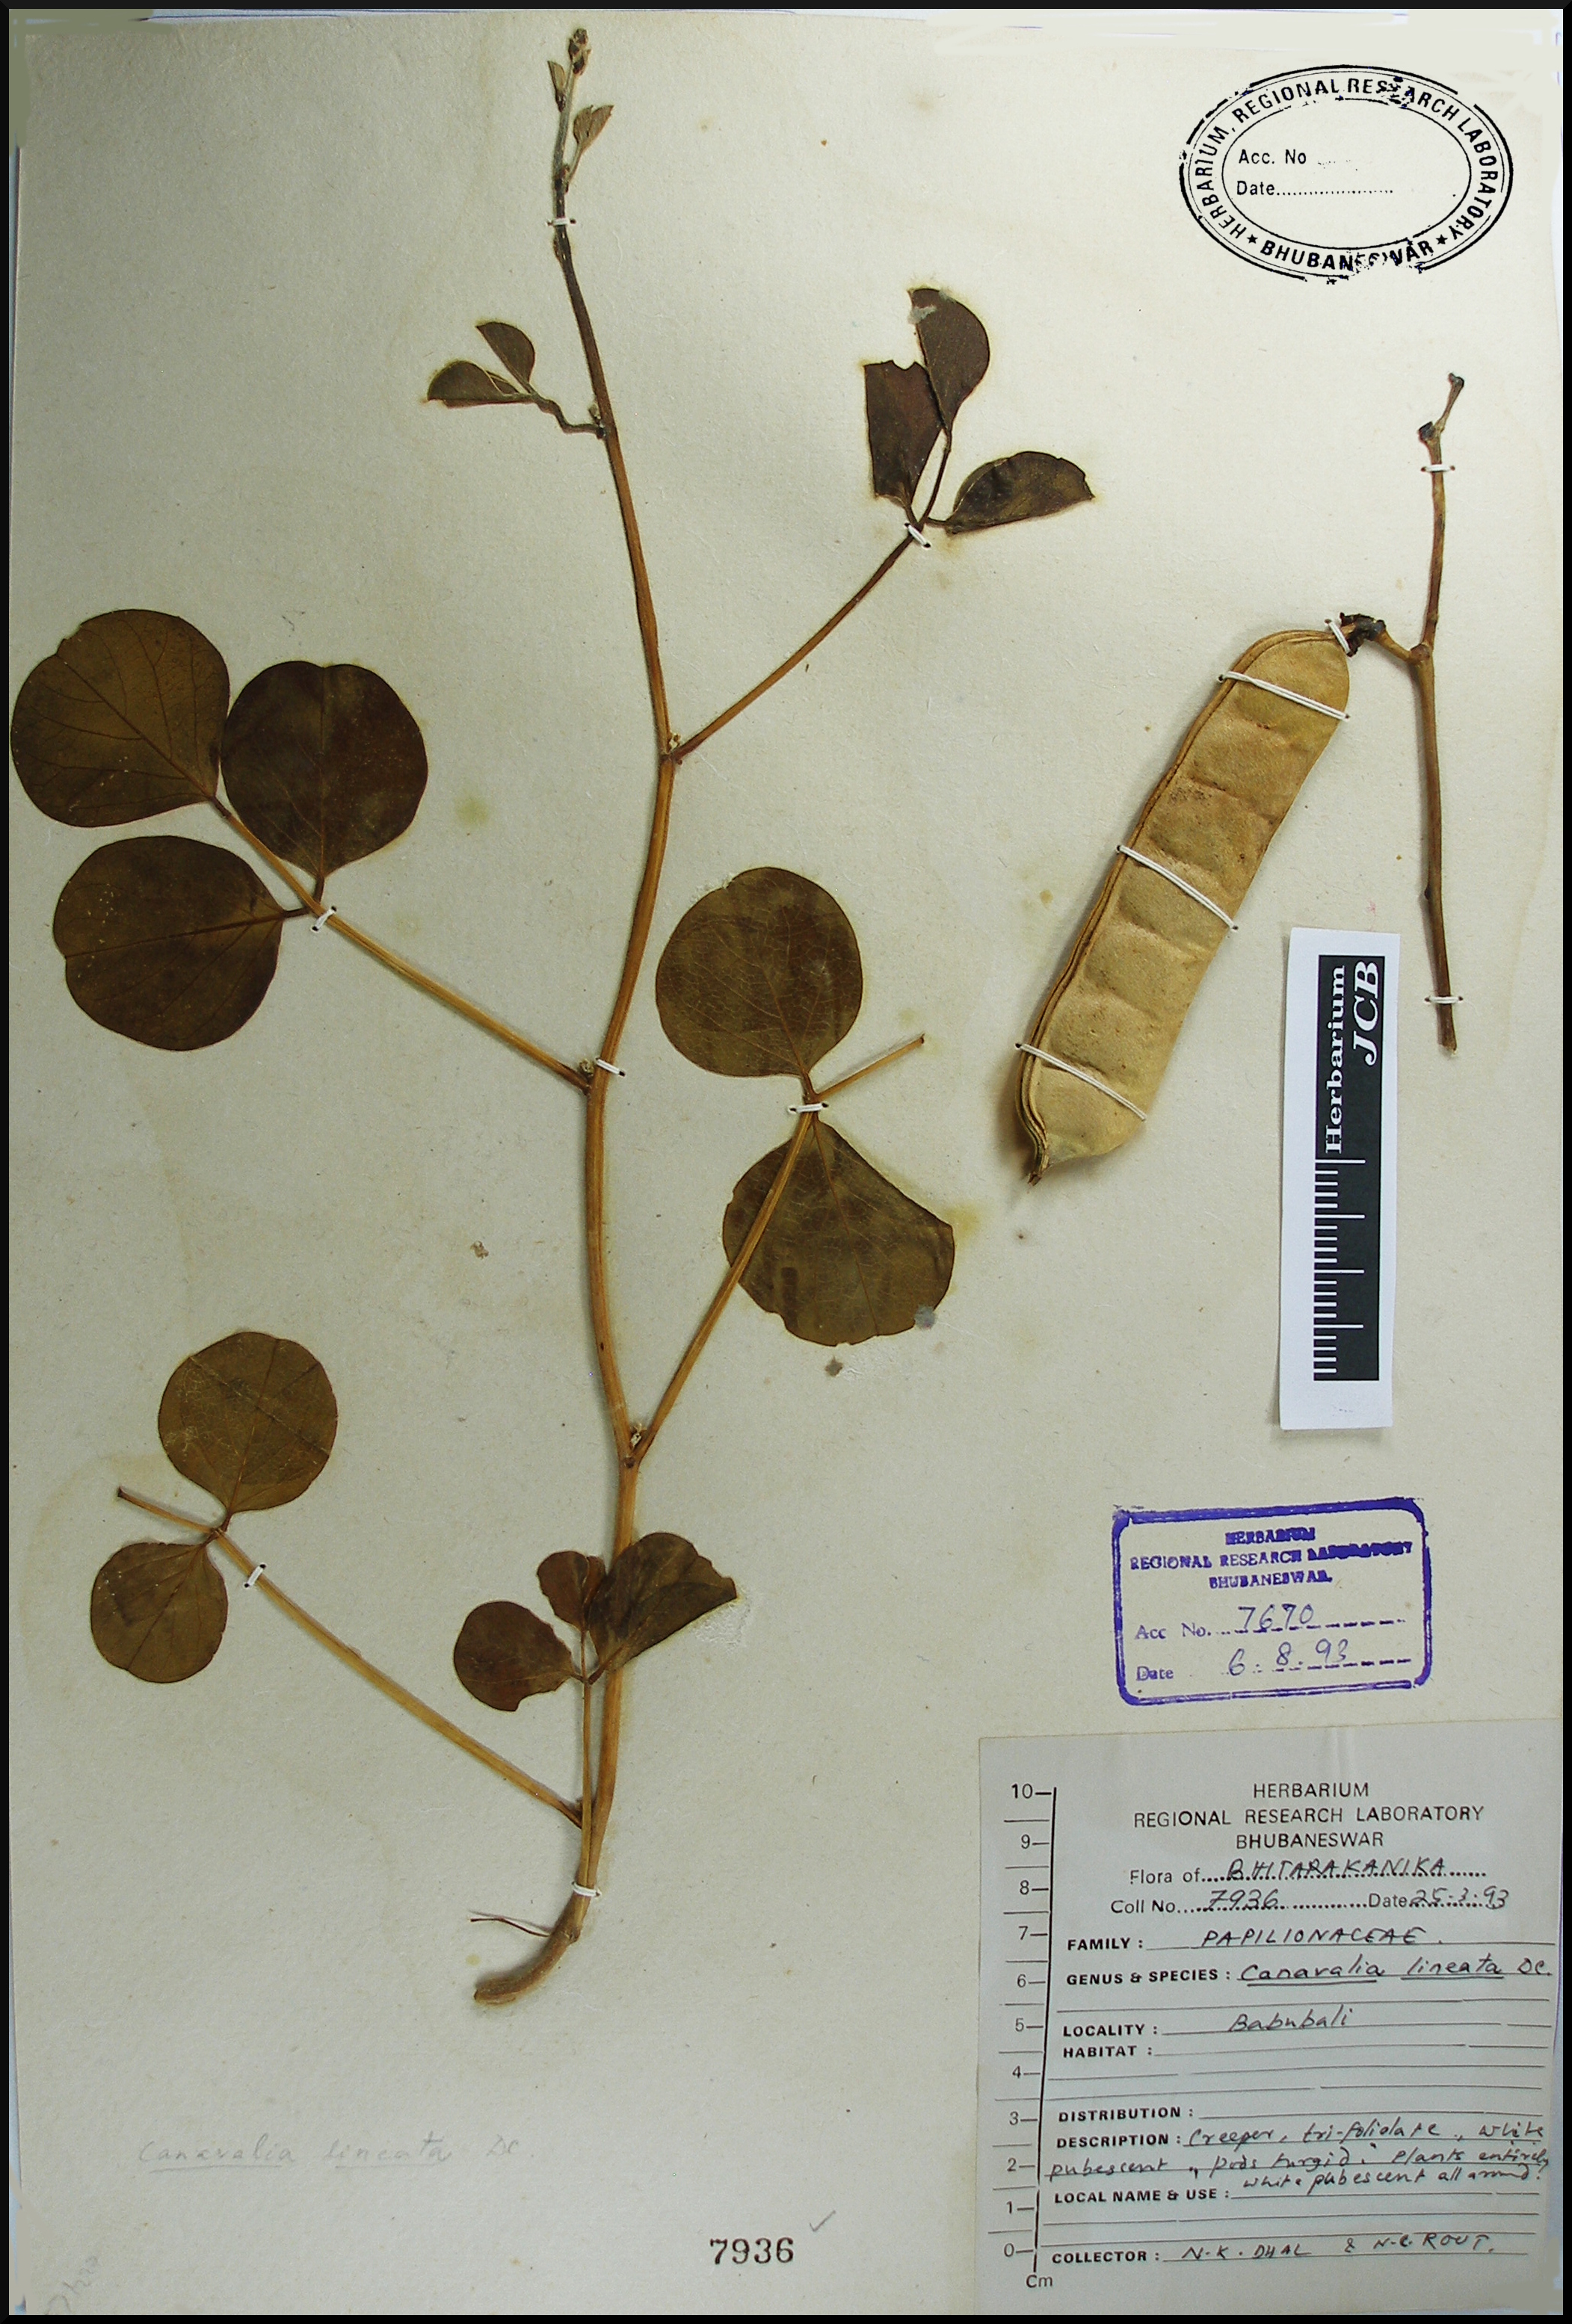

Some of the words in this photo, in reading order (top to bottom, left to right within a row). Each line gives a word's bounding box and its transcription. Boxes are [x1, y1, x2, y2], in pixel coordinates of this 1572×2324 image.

[1232, 79, 1340, 123] REGIONAL
[1449, 117, 1499, 240] LABORATORY
[1239, 149, 1274, 164] Acc.
[1286, 149, 1307, 164] No
[1352, 960, 1379, 1066] JCB
[1325, 965, 1346, 1155] Herbarium
[1130, 1554, 1212, 1570] REGIONAL
[1219, 1550, 1302, 1568] RESEARCH
[1237, 1604, 1314, 1631] 7670
[1135, 1625, 1167, 1640] Acc
[1135, 1666, 1174, 1681] Date
[1011, 1783, 1033, 1799] 10
[1254, 1782, 1369, 1798] HERBARIUM
[1134, 1810, 1231, 1828] REGIONAL
[1245, 1808, 1343, 1824] RESEARCH
[1357, 1805, 1485, 1822] LABORATORY
[1020, 1834, 1031, 1849] 9
[1236, 1832, 1384, 1849] BHUBANESWAR
[1130, 1870, 1173, 1885] Flora
[1020, 1880, 1030, 1895] 8
[1111, 1899, 1144, 1914] Coll
[1208, 1888, 1280, 1912] 7936
[1369, 1893, 1407, 1909] Date
[1018, 1926, 1029, 1941] 7
[1017, 1974, 1026, 1988] 6
[1066, 1973, 1123, 1985] GENUS
[1130, 1973, 1143, 1984] &
[1015, 2018, 1025, 2033] 5
[1011, 2066, 1022, 2079] 4
[1008, 2111, 1019, 2126] 3
[1008, 2157, 1017, 2172] 2
[1055, 2192, 1107, 2204] LOCAL
[1112, 2190, 1162, 2203] NAME
[1167, 2190, 1180, 2201] &
[1006, 2201, 1013, 2215] 1
[709, 2237, 794, 2265] 7936
[1344, 2237, 1355, 2253] &
[1026, 2273, 1053, 2289] Cm
